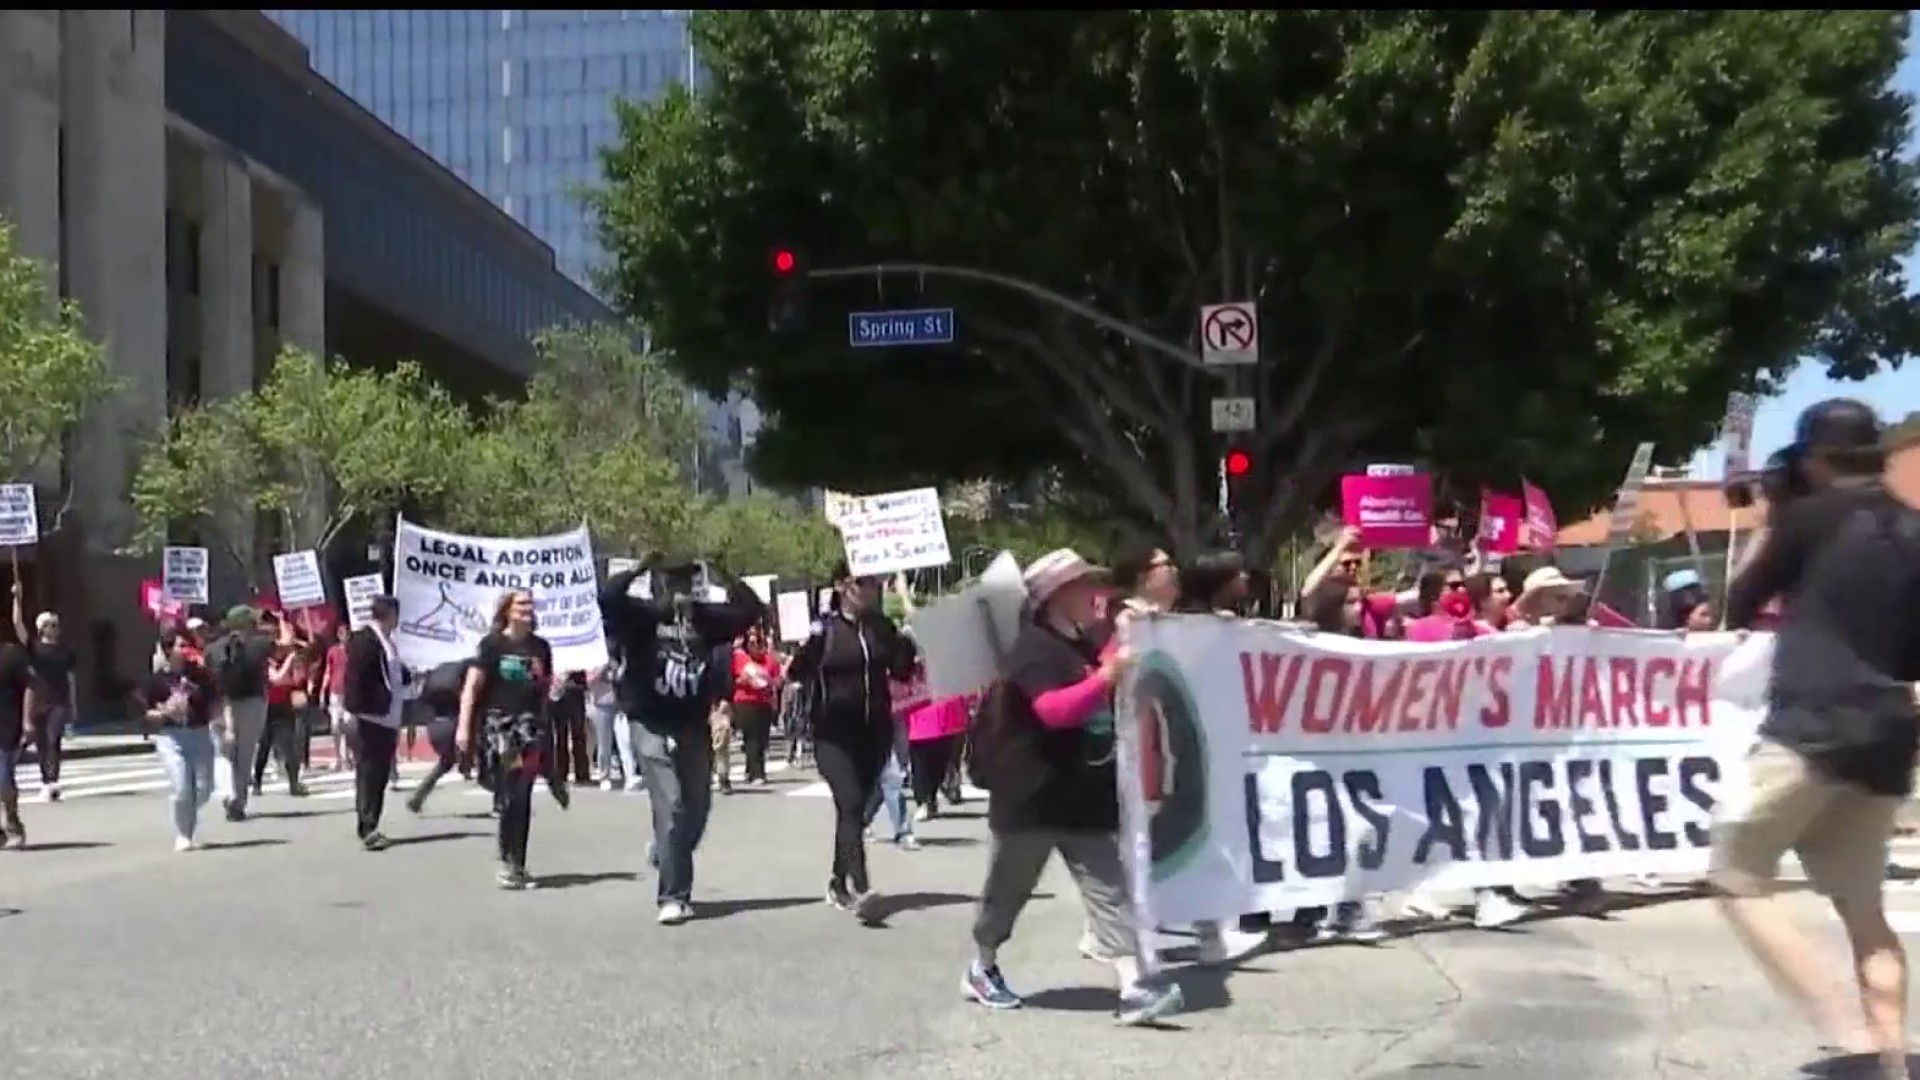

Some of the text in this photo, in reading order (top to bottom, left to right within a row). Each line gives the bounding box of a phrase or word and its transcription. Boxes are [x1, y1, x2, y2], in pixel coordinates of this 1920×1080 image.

[860, 315, 944, 340] Spring St
[420, 536, 585, 567] LEGAL ABORTION
[406, 555, 468, 583] ONCE
[474, 570, 523, 588] AND
[529, 570, 567, 590] FOR
[654, 650, 706, 698] JOY
[1240, 651, 1712, 734] WOMEN'S MARCH
[1244, 756, 1722, 884] LOS ANGELES
